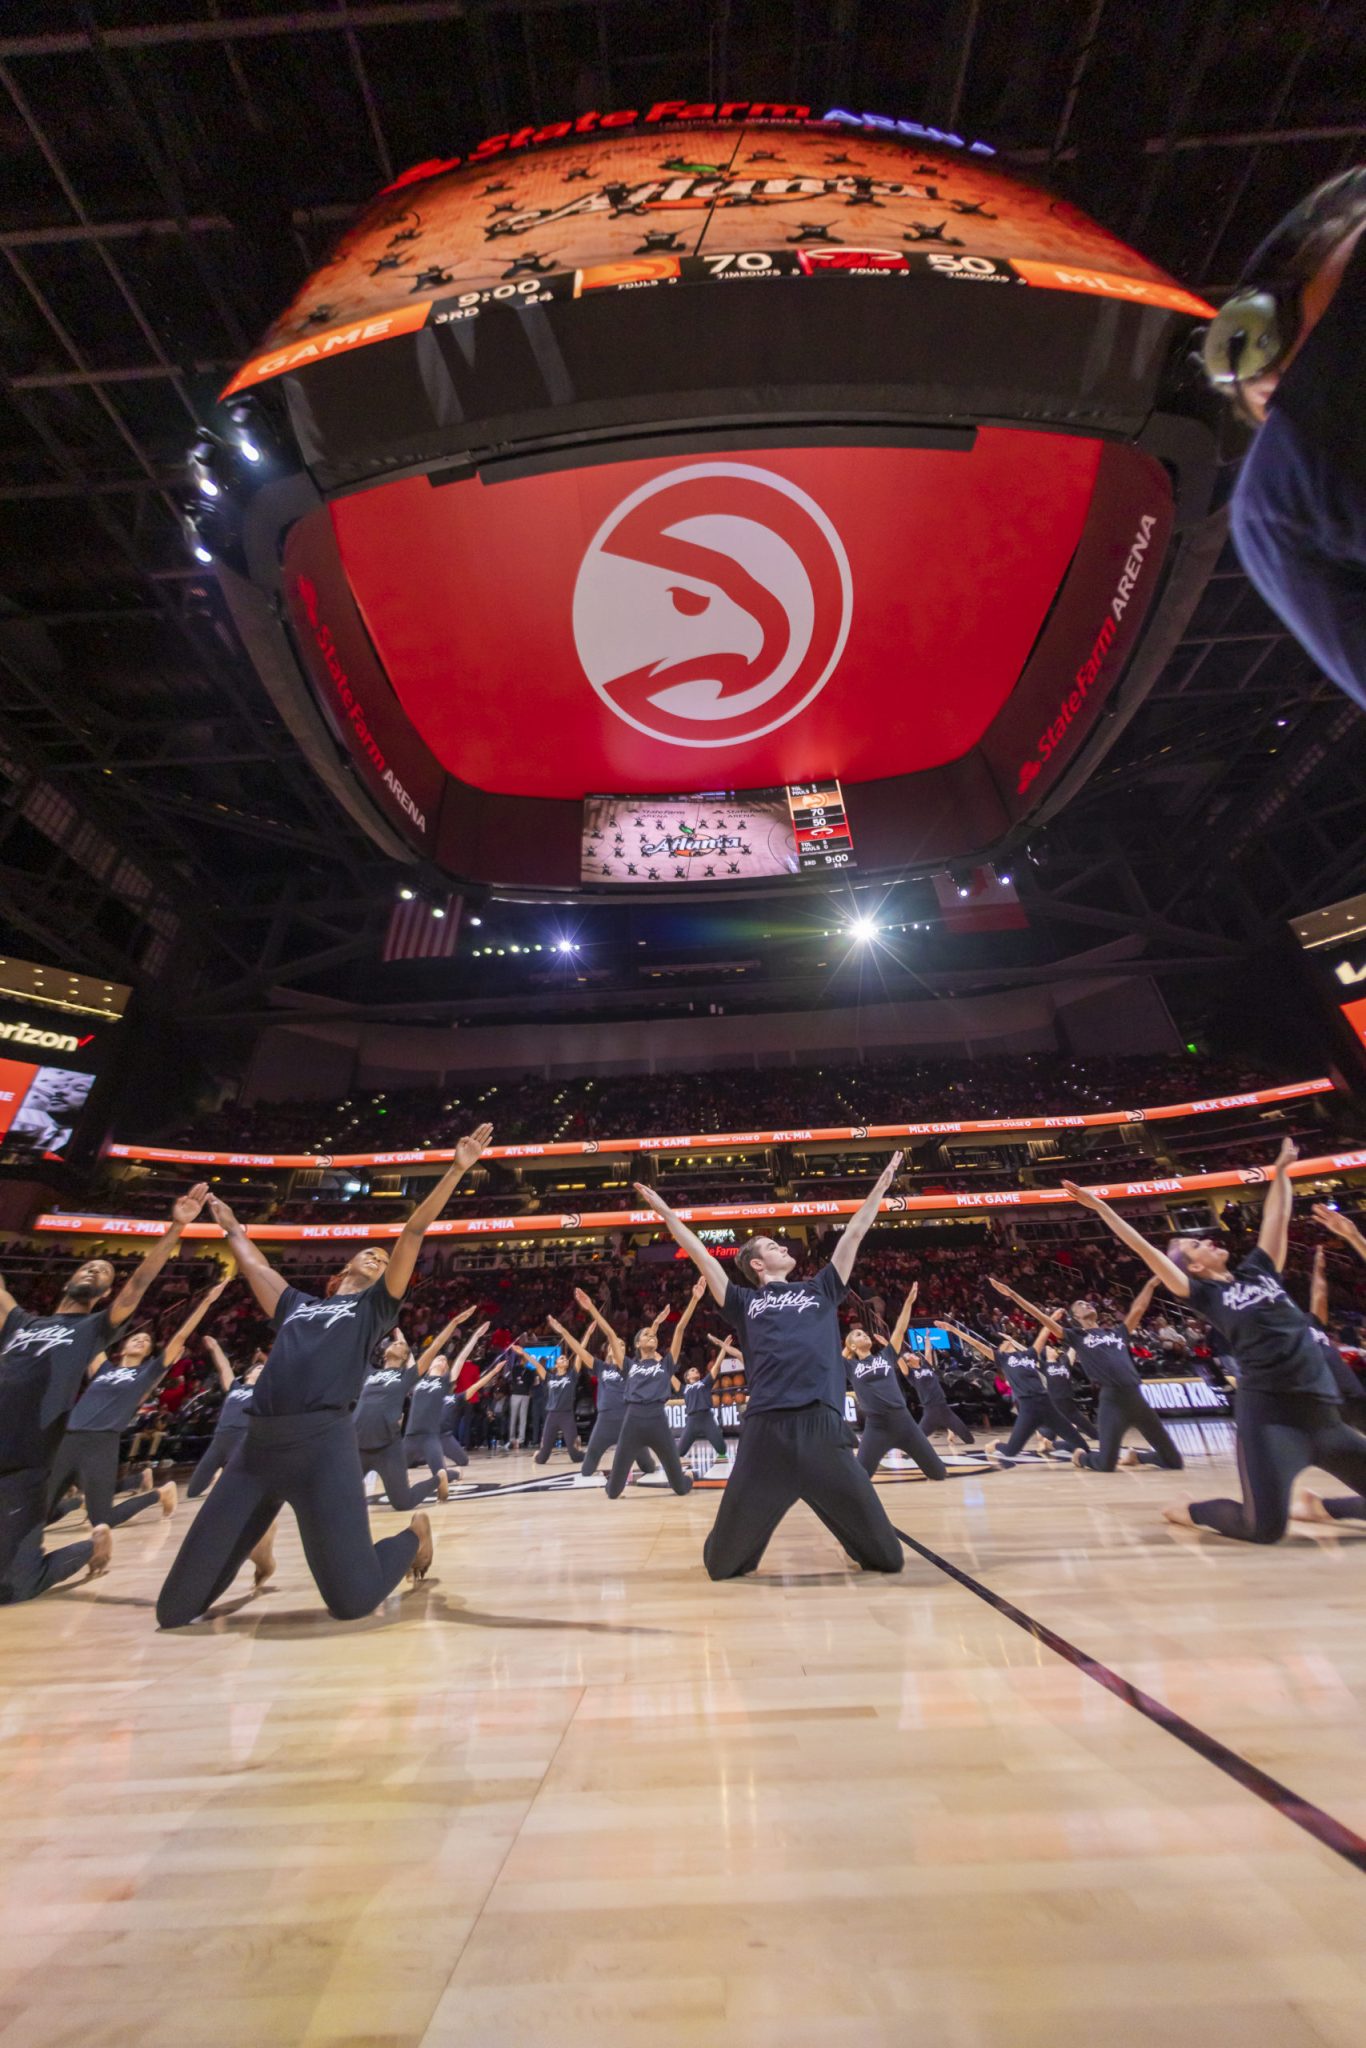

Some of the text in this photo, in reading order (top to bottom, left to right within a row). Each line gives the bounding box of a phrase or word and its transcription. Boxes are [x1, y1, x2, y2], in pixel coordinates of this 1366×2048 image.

[468, 111, 639, 161] State
[644, 100, 810, 122] Farm
[702, 252, 773, 275] 70
[927, 252, 997, 275] 50
[717, 269, 782, 281] TIMEOUTS
[850, 267, 891, 277] FOULS
[617, 279, 659, 291] FOULS
[458, 279, 541, 308] 9:00
[525, 292, 553, 305] 24
[435, 307, 480, 325] 3RD
[256, 319, 393, 376] GAME
[1039, 514, 1157, 763] State Farm ARENA
[316, 623, 426, 833] State Farm ARENA
[811, 808, 825, 817] 70
[812, 818, 827, 827] 50
[641, 836, 742, 854] Atlanta
[825, 853, 849, 864] 9:00
[0, 1022, 79, 1052] rizon
[1191, 1102, 1219, 1111] MLK
[1220, 1095, 1259, 1106] GAME
[908, 1125, 931, 1134] MLK
[931, 1123, 961, 1132] GAME
[639, 1139, 661, 1148] MLK
[662, 1137, 691, 1147] GAME
[373, 1155, 397, 1163] MLK
[397, 1152, 425, 1162] GAME
[956, 1195, 982, 1205] MLK
[984, 1193, 1021, 1204] GAME
[629, 1213, 656, 1222] MLK
[302, 1227, 329, 1237] MLK
[332, 1226, 369, 1237] GAME
[716, 1245, 740, 1257] Farm
